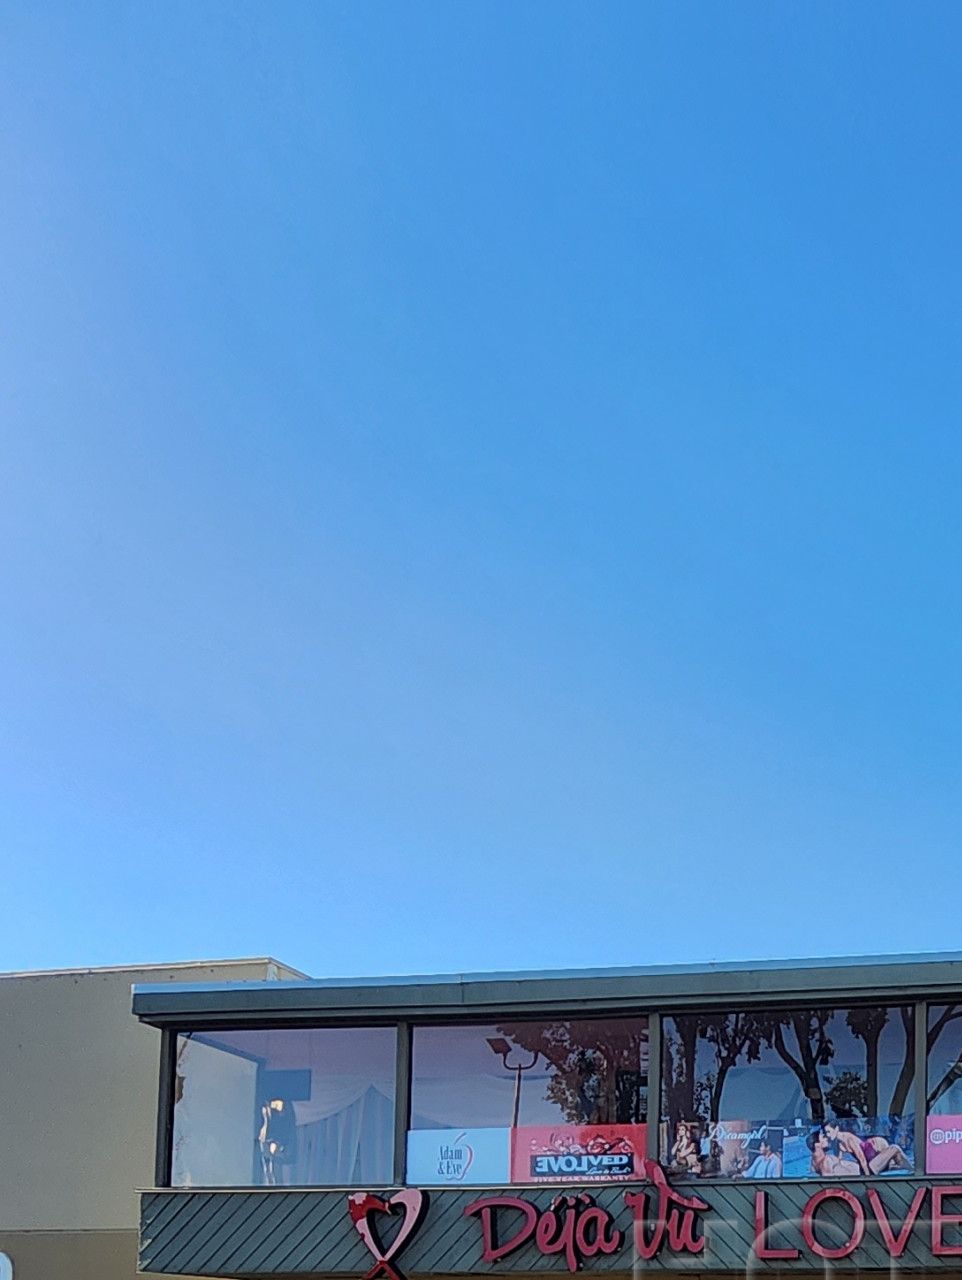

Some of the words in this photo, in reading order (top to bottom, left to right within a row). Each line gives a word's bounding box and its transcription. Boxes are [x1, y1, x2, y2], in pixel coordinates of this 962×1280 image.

[438, 1146, 462, 1160] Adam
[437, 1162, 445, 1175] &
[446, 1161, 462, 1175] Eve
[535, 1155, 628, 1172] EVOLVED
